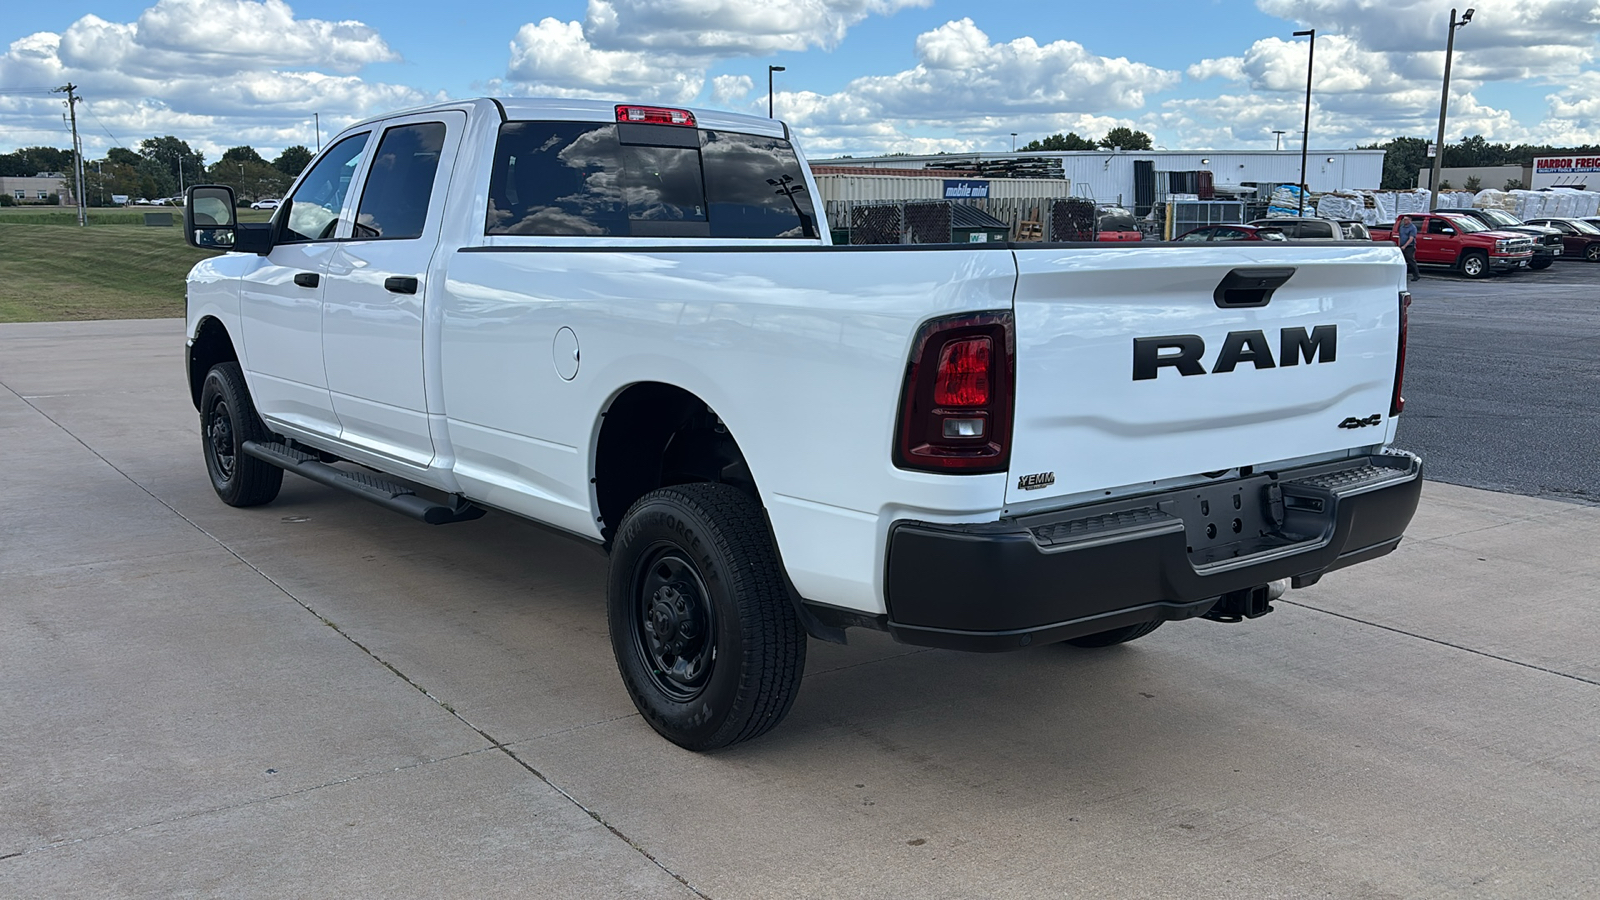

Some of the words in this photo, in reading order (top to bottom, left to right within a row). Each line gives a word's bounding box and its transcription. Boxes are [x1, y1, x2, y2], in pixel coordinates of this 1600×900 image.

[1537, 158, 1573, 168] HARBOR
[945, 183, 971, 197] mobile
[971, 185, 989, 197] mini
[1132, 324, 1337, 381] RAM
[1337, 414, 1382, 429] 4x4
[1019, 472, 1054, 486] YEMM
